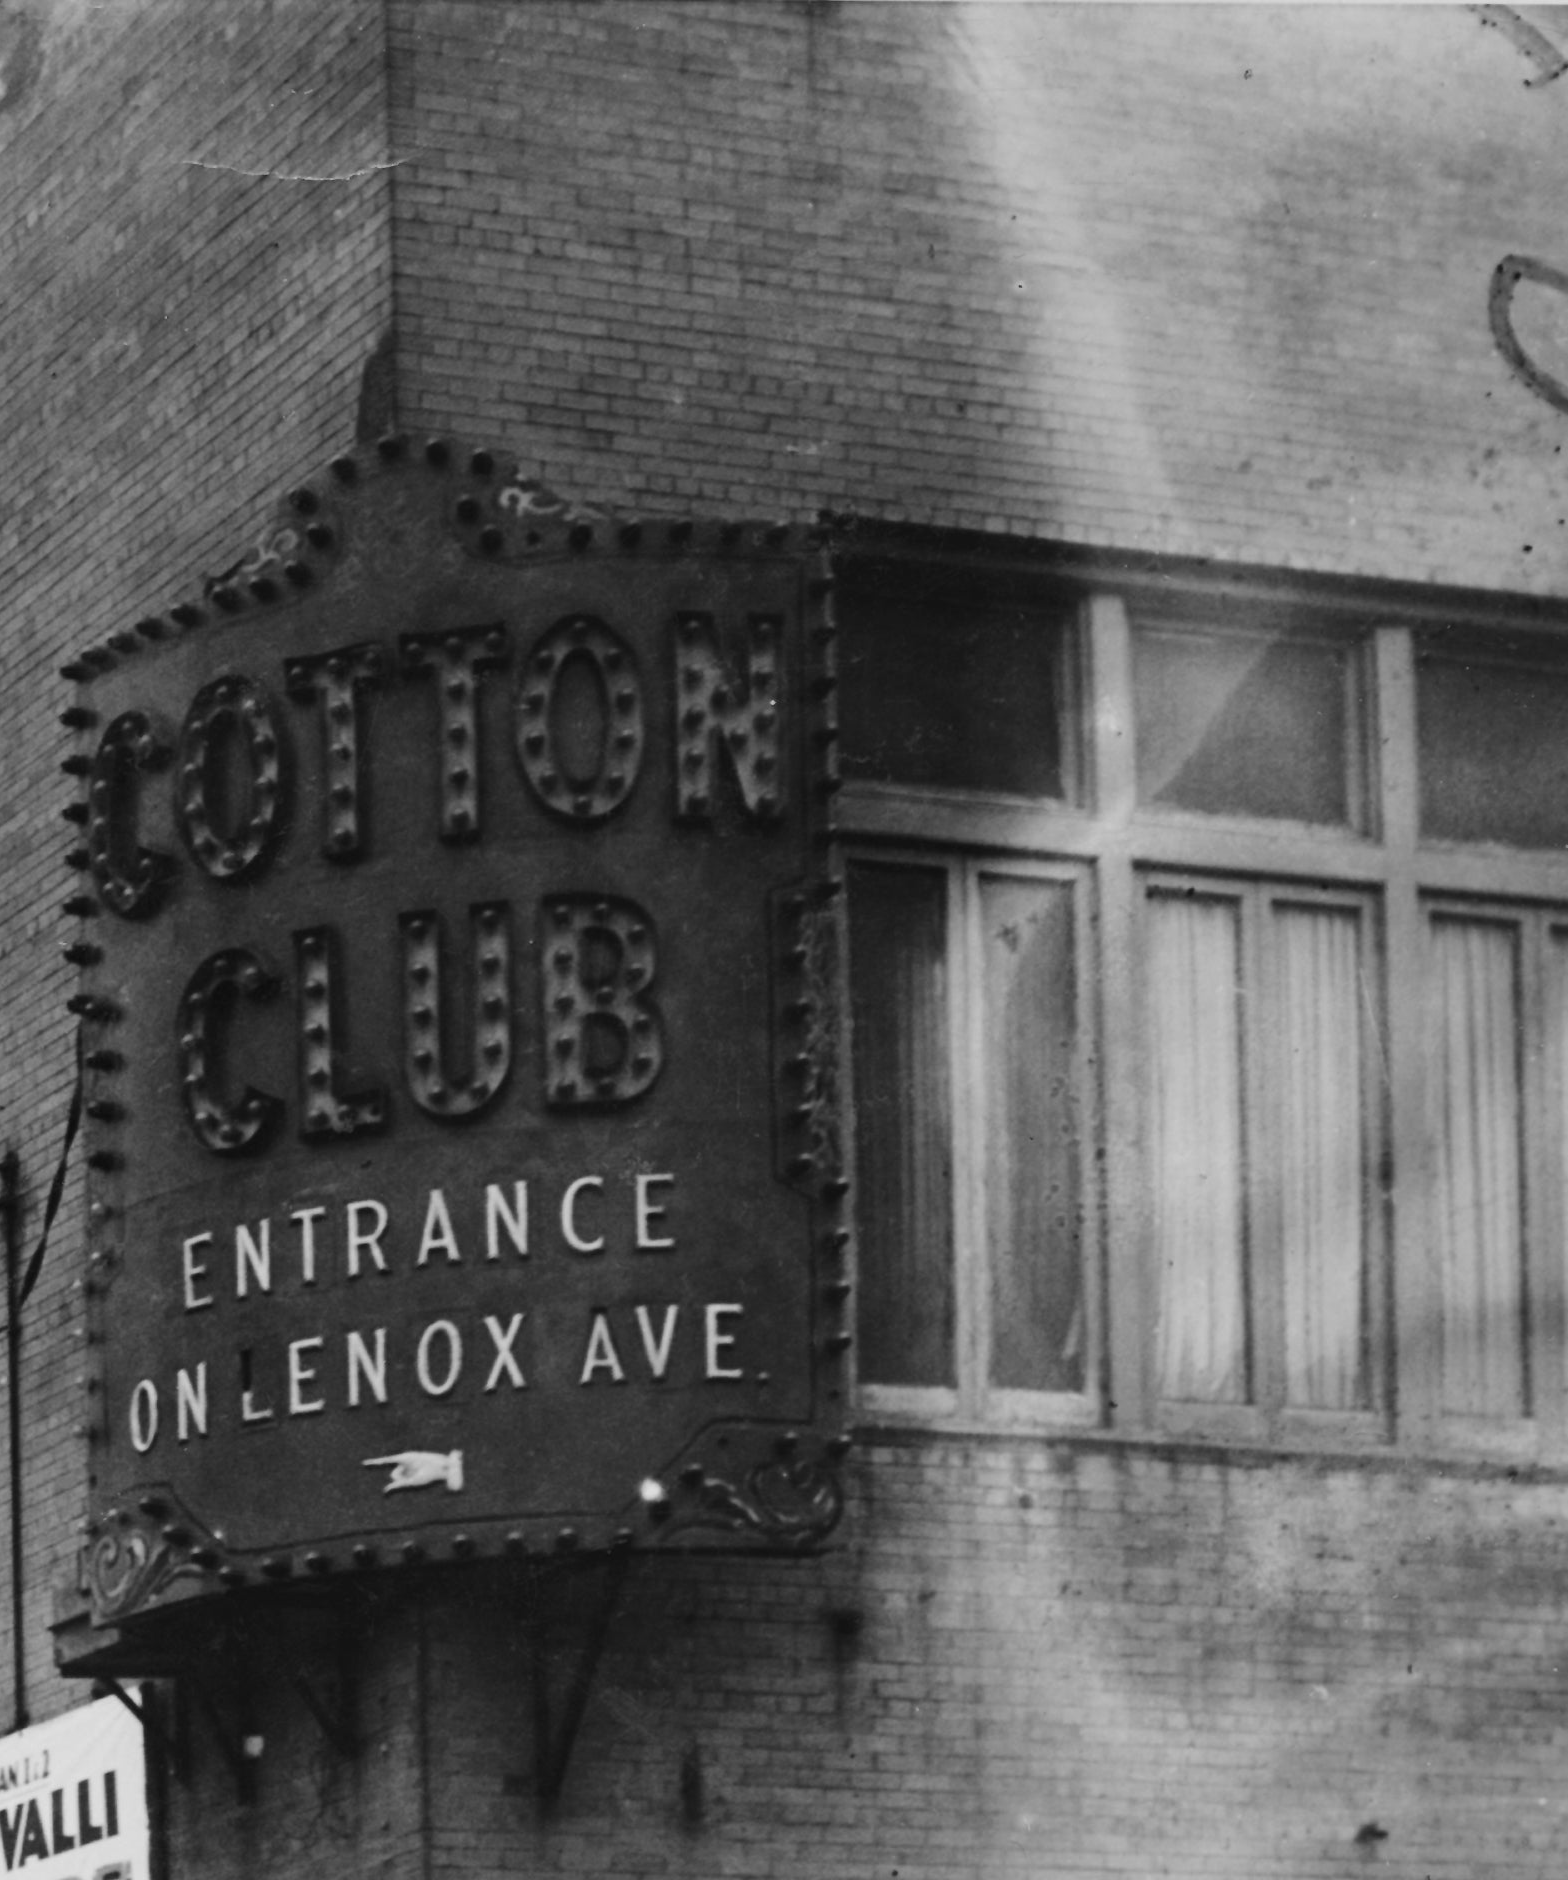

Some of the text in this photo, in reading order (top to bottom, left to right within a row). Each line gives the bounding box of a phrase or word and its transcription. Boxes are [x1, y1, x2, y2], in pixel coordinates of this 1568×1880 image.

[89, 611, 785, 919] COTTON
[177, 891, 664, 1154] CLUB
[182, 1172, 677, 1312] ENTRANCE
[128, 1360, 208, 1455] ON
[238, 1312, 529, 1425] LENOX
